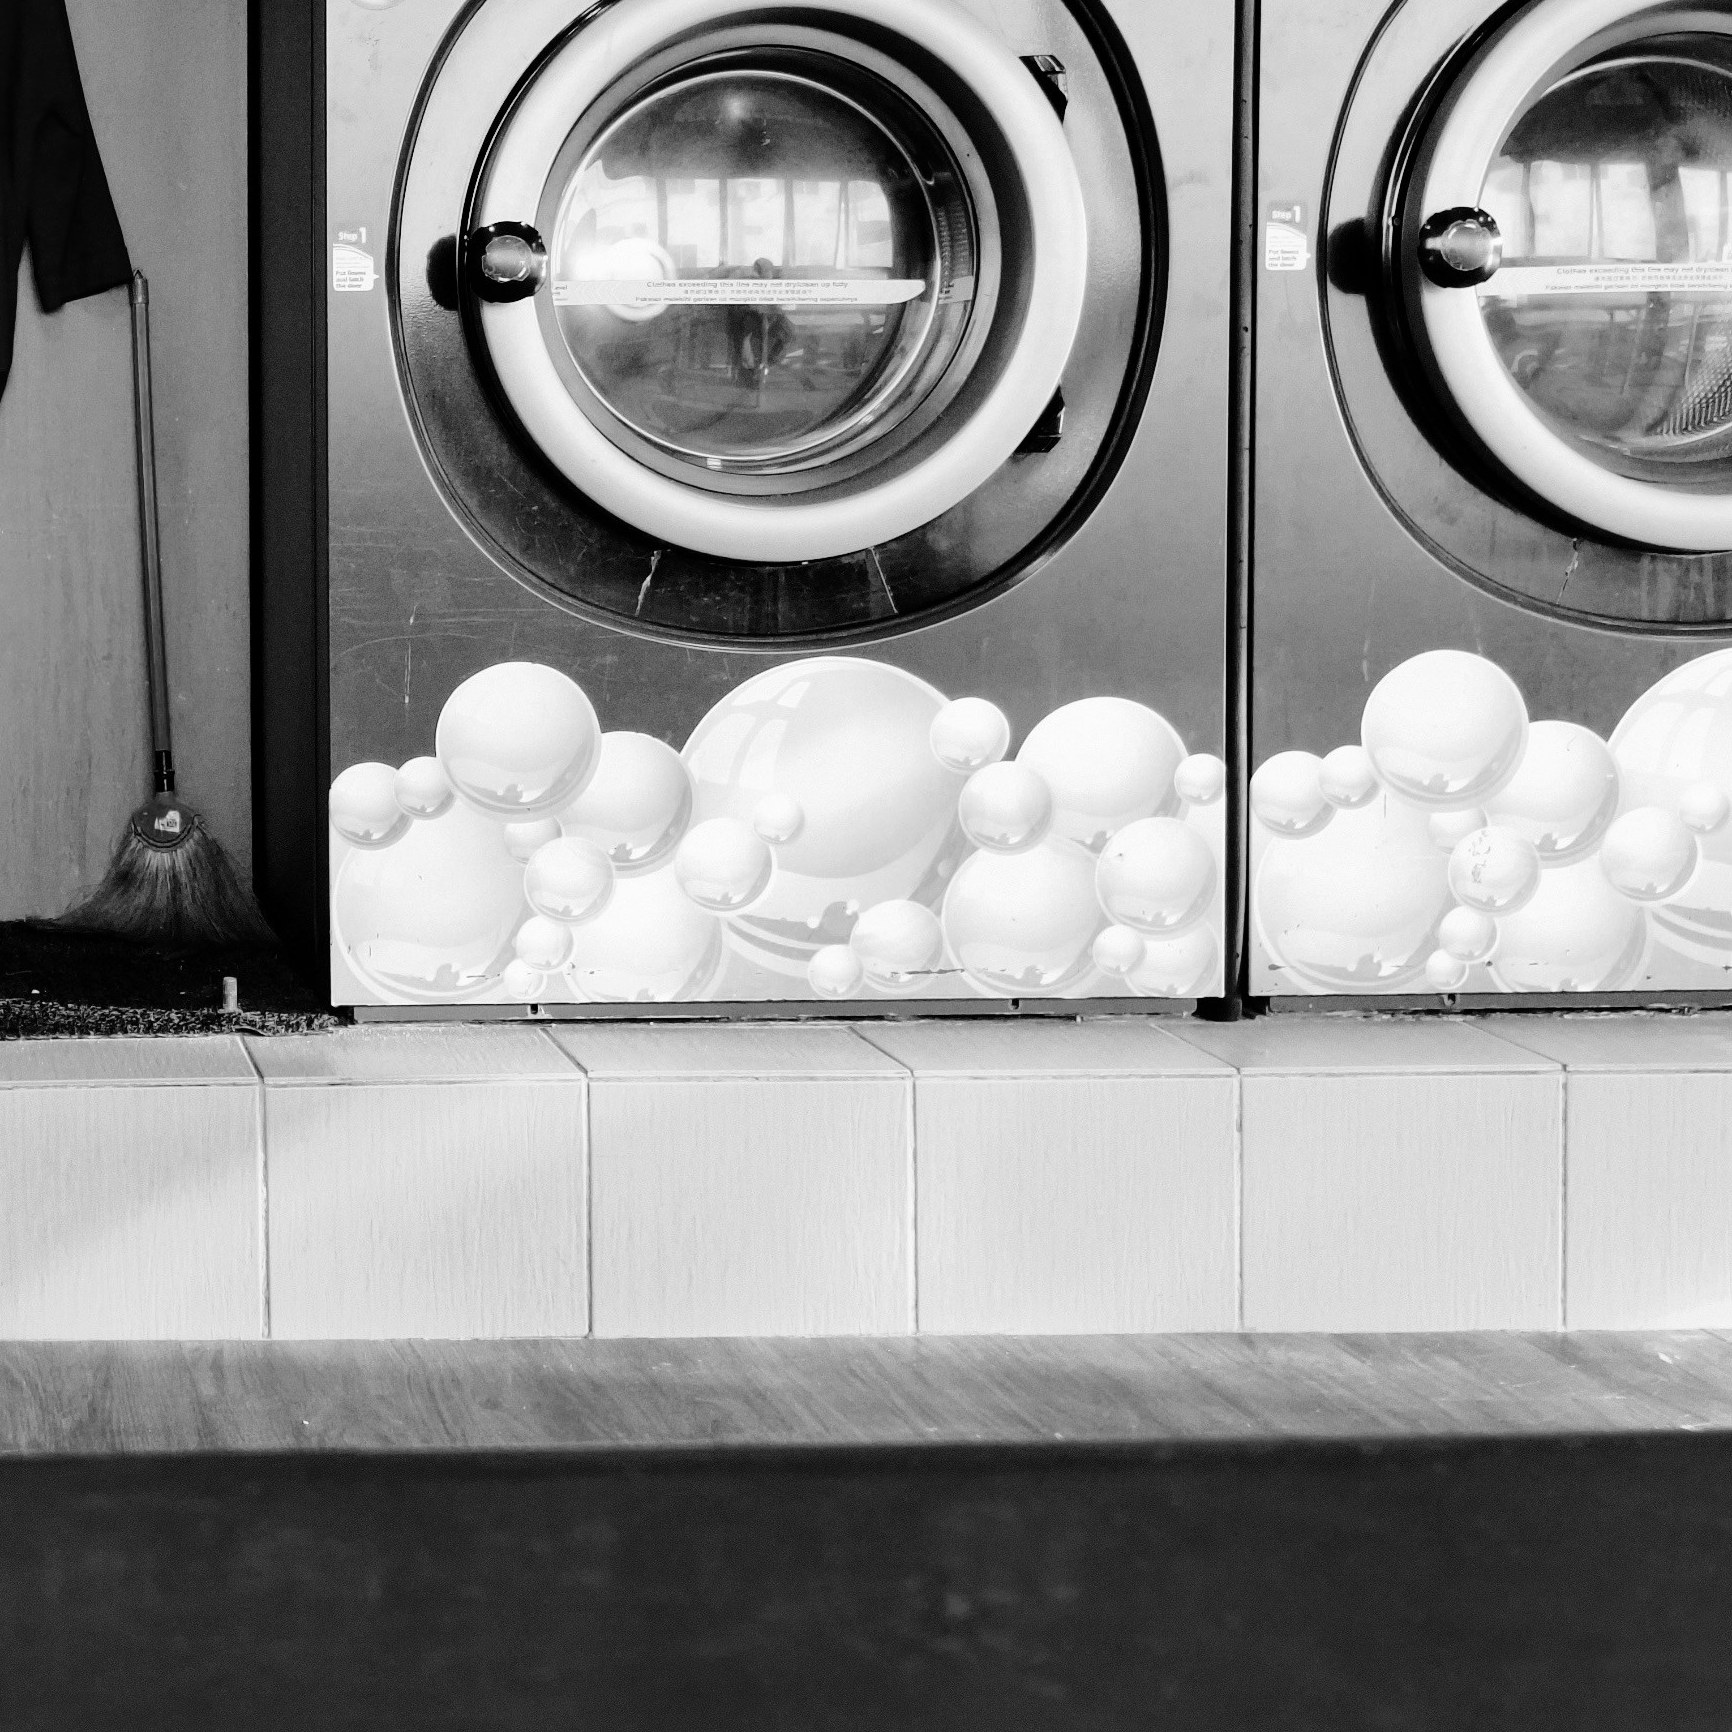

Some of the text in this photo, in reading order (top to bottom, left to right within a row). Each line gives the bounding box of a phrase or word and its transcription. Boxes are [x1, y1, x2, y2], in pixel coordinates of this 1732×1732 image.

[1271, 205, 1301, 224] Step 1
[338, 227, 367, 244] Step 1
